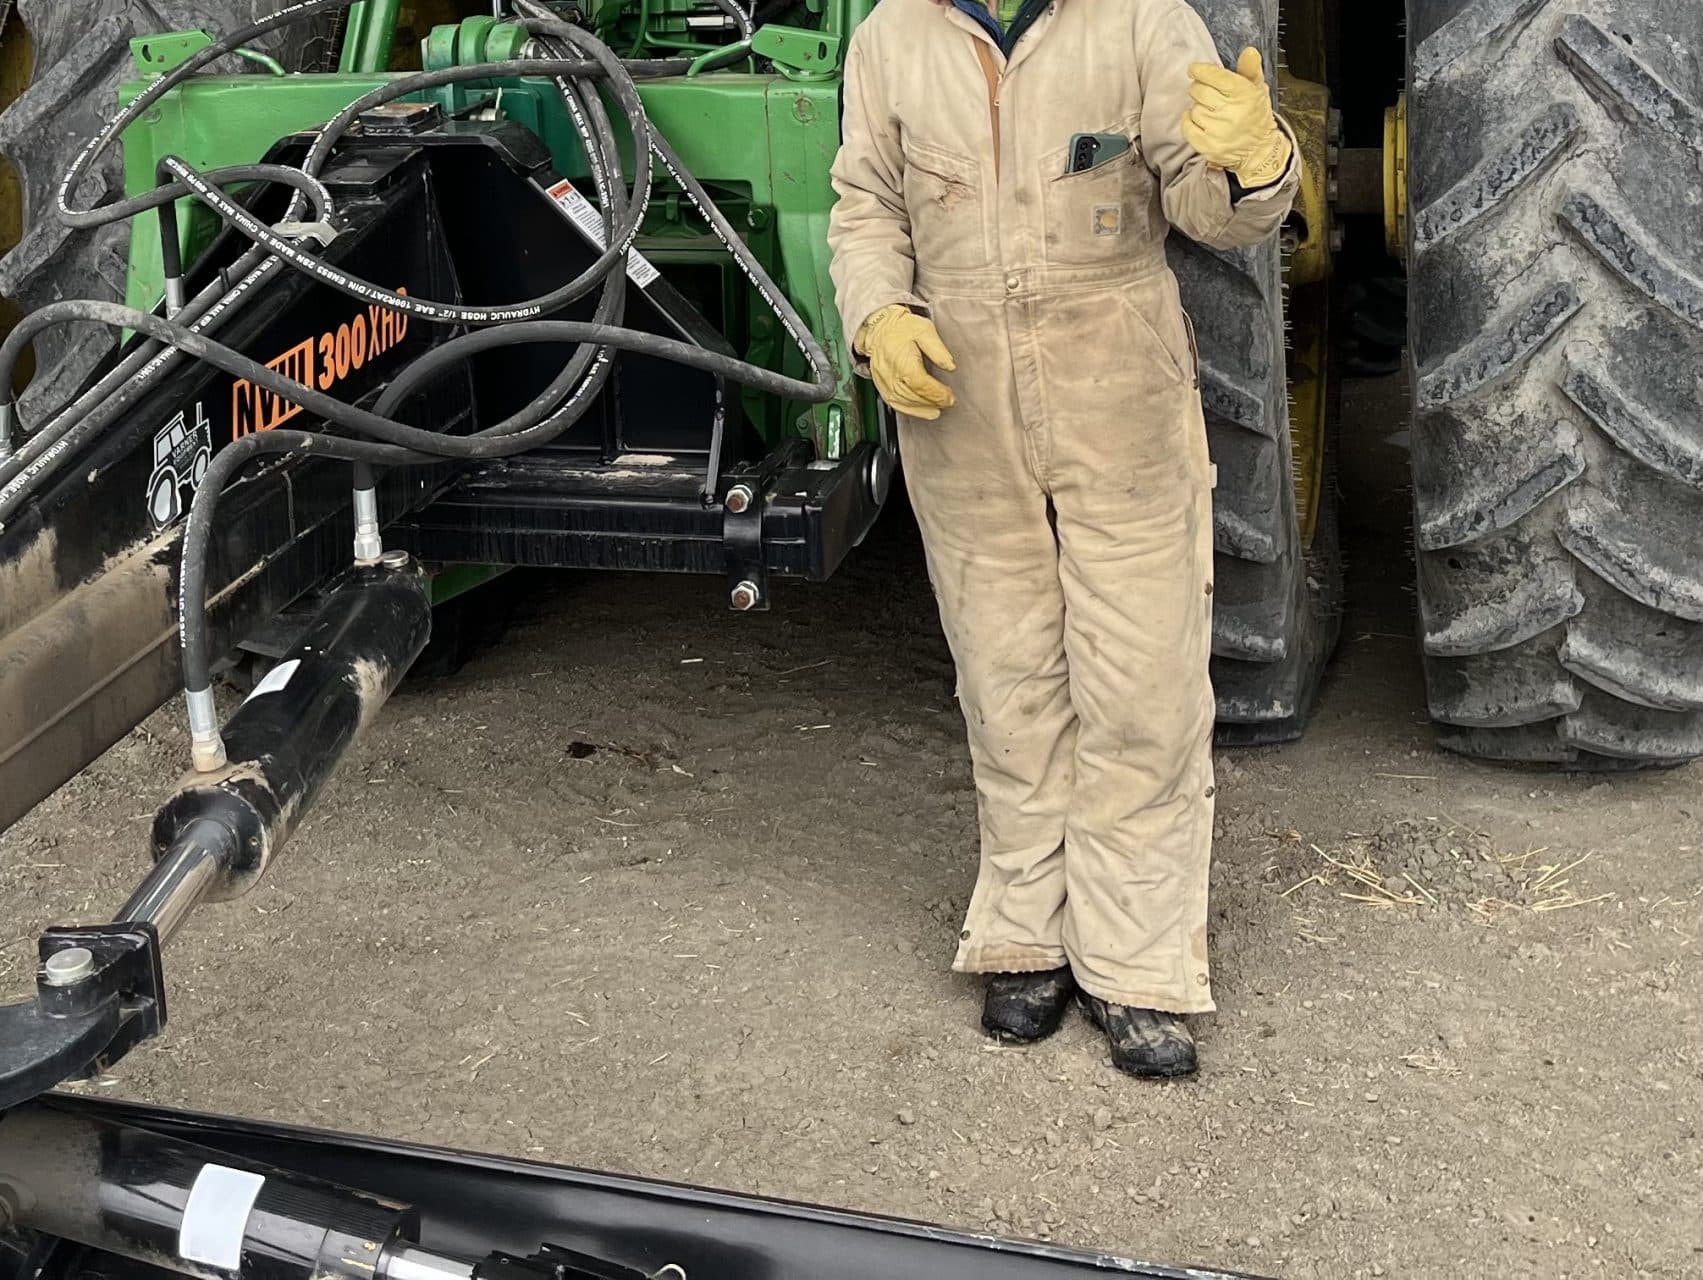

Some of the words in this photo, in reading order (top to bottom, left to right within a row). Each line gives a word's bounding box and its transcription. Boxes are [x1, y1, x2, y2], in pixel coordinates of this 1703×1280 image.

[218, 200, 235, 216] MAX
[234, 212, 259, 234] CHINA
[258, 230, 270, 241] IN
[269, 237, 296, 258] MADE
[414, 304, 435, 314] SAE
[461, 312, 487, 320] HOSE
[491, 305, 541, 320] HYDRAULIC
[27, 440, 69, 475] HYDRAULIC
